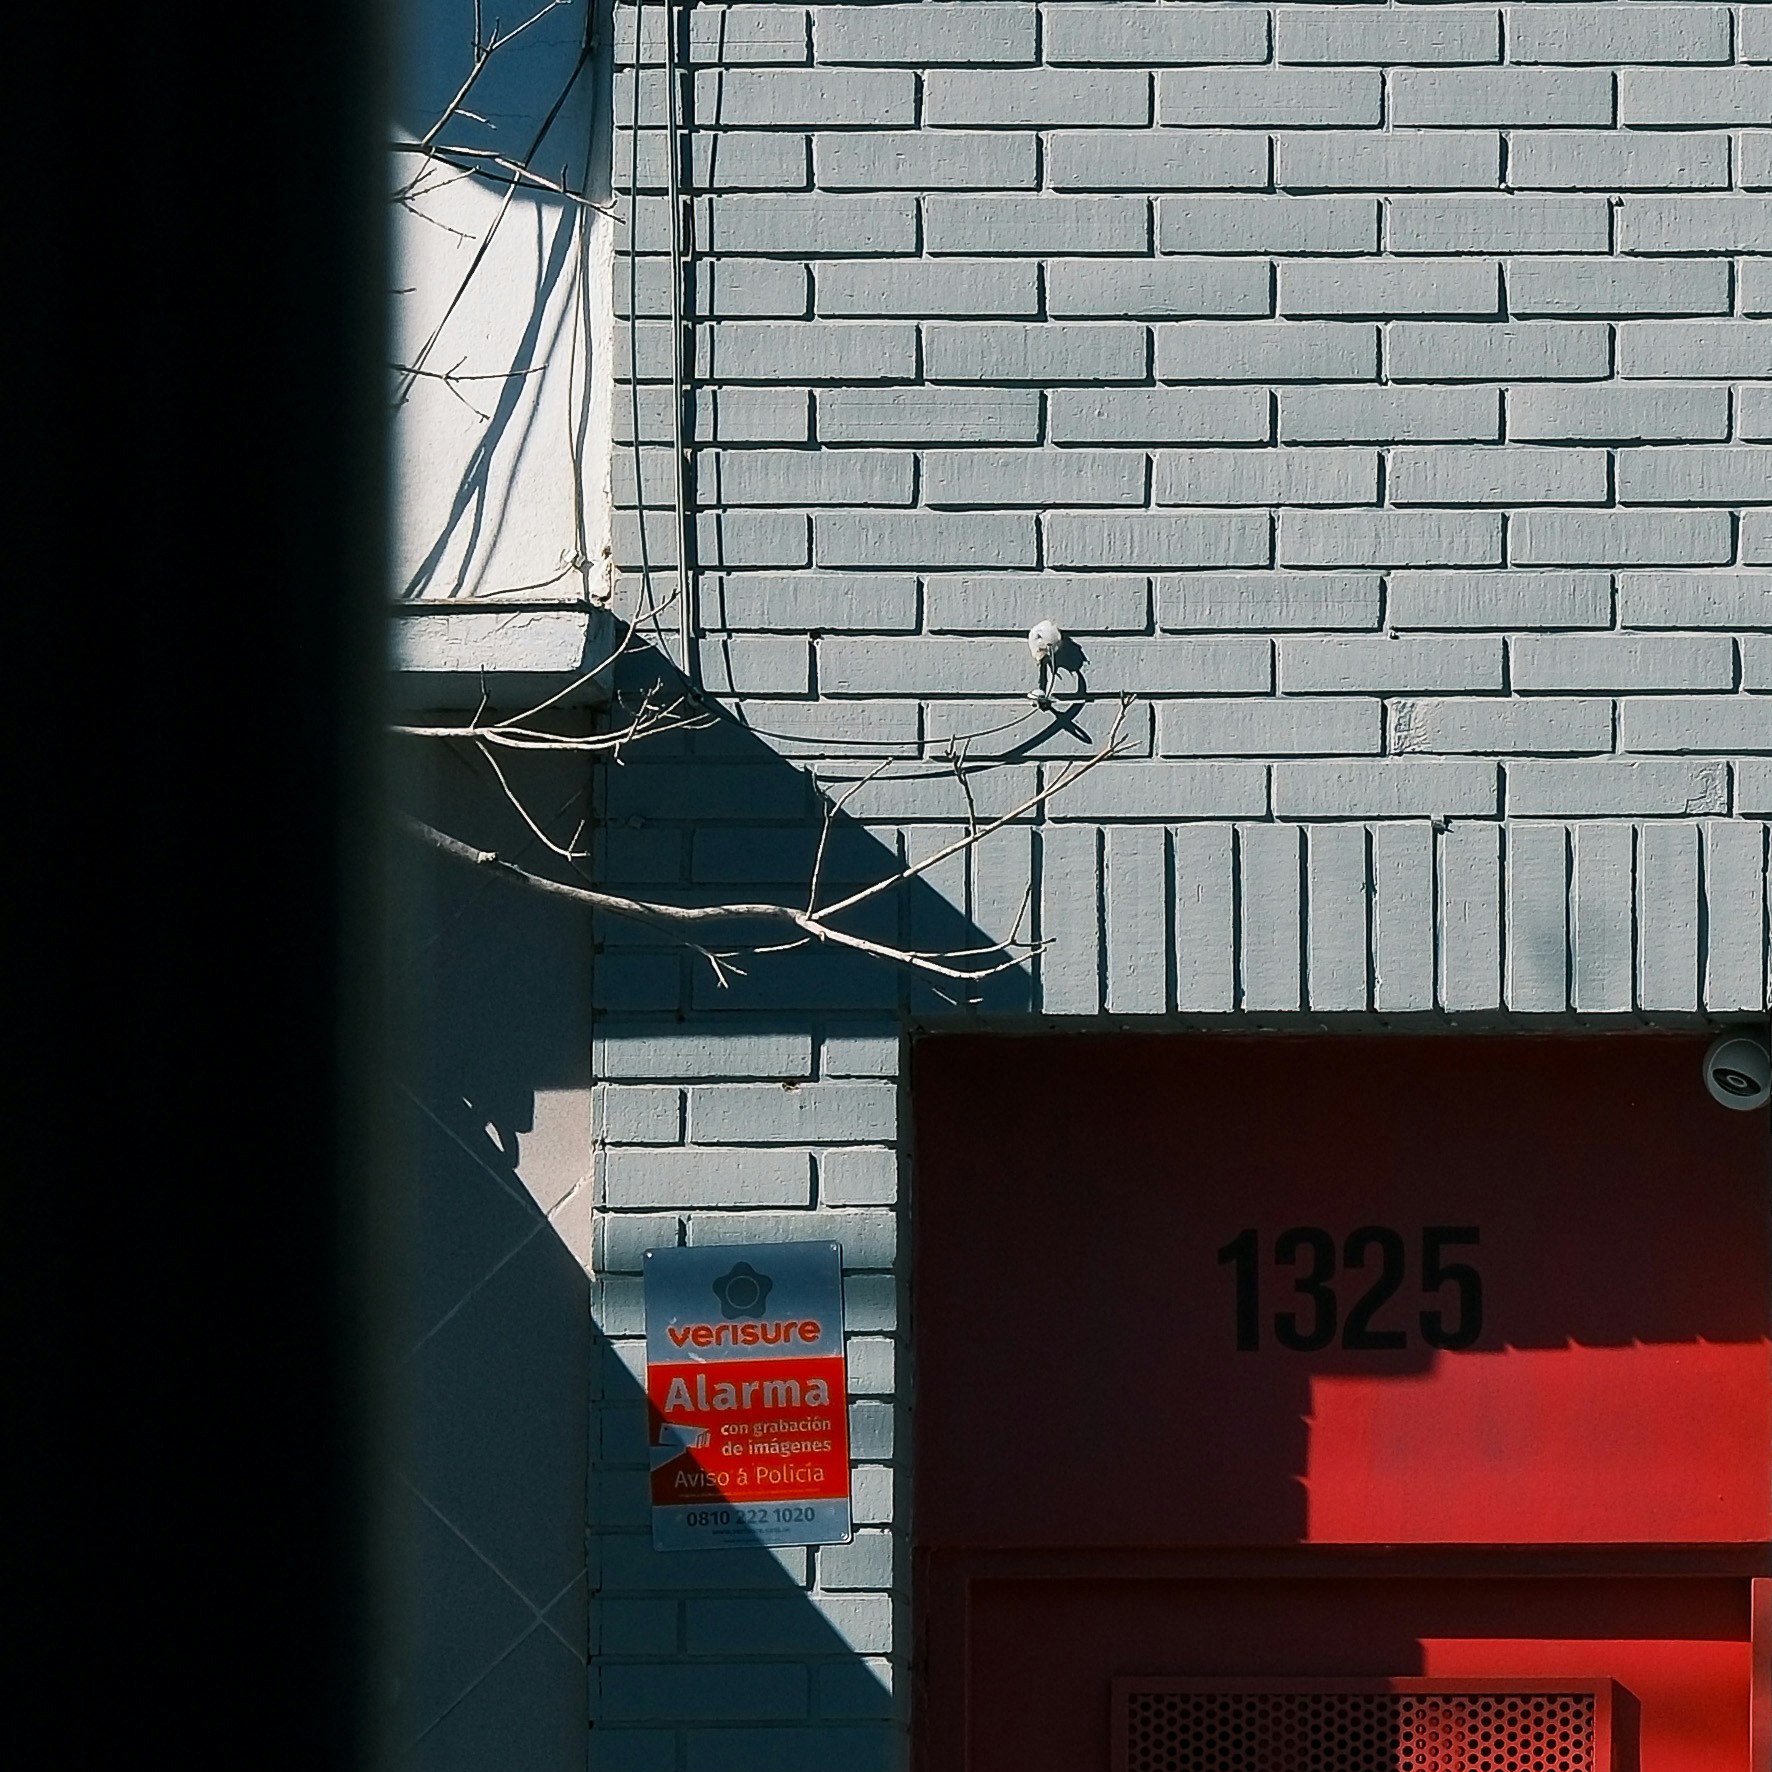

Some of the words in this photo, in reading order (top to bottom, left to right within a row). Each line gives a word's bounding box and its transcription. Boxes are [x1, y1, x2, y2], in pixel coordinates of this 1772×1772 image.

[1217, 1225, 1483, 1352] 1325
[668, 1321, 820, 1348] verisure
[665, 1374, 830, 1413] Alarma
[720, 1423, 749, 1436] con
[753, 1416, 832, 1437] grabación
[721, 1441, 744, 1457] de
[748, 1437, 832, 1458] imágenes
[674, 1467, 730, 1488] Aviso
[756, 1462, 826, 1485] Policía
[686, 1510, 731, 1527] 0810
[735, 1508, 769, 1525] 222
[773, 1506, 816, 1523] 1020
